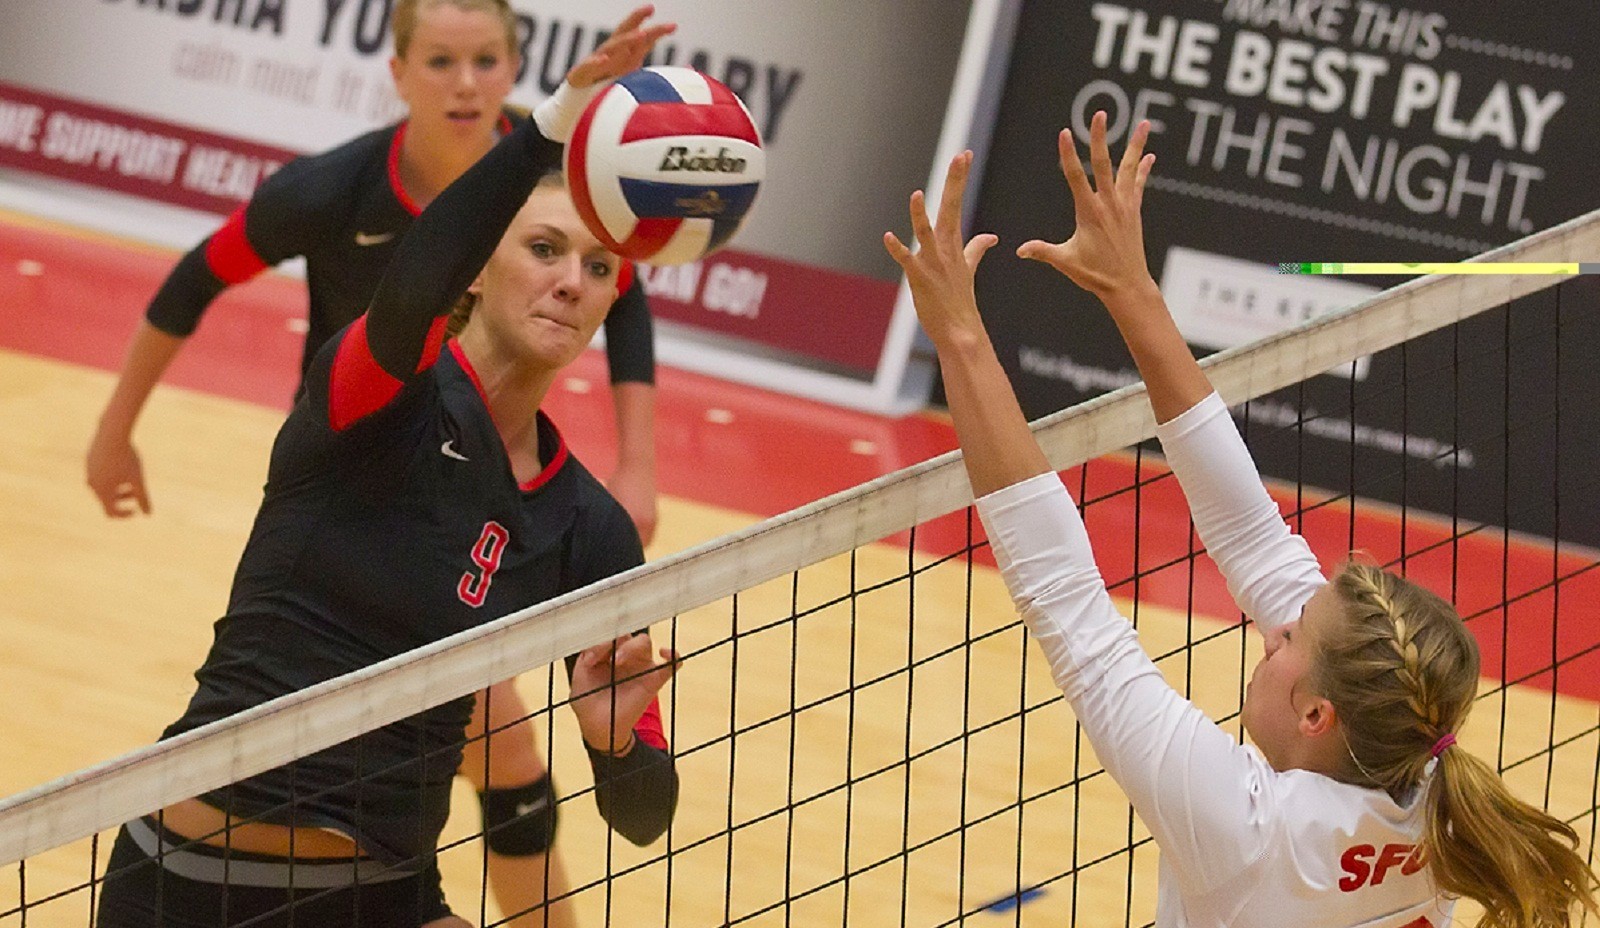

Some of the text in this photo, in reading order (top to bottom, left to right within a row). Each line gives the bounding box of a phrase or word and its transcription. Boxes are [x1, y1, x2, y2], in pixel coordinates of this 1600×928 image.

[1222, 0, 1449, 60] MAKE THIS
[1092, 4, 1566, 153] THE BEST PLAY
[41, 111, 189, 187] SUPPORT
[1071, 79, 1547, 234] OF THE NIGHT.
[457, 520, 510, 609] 9
